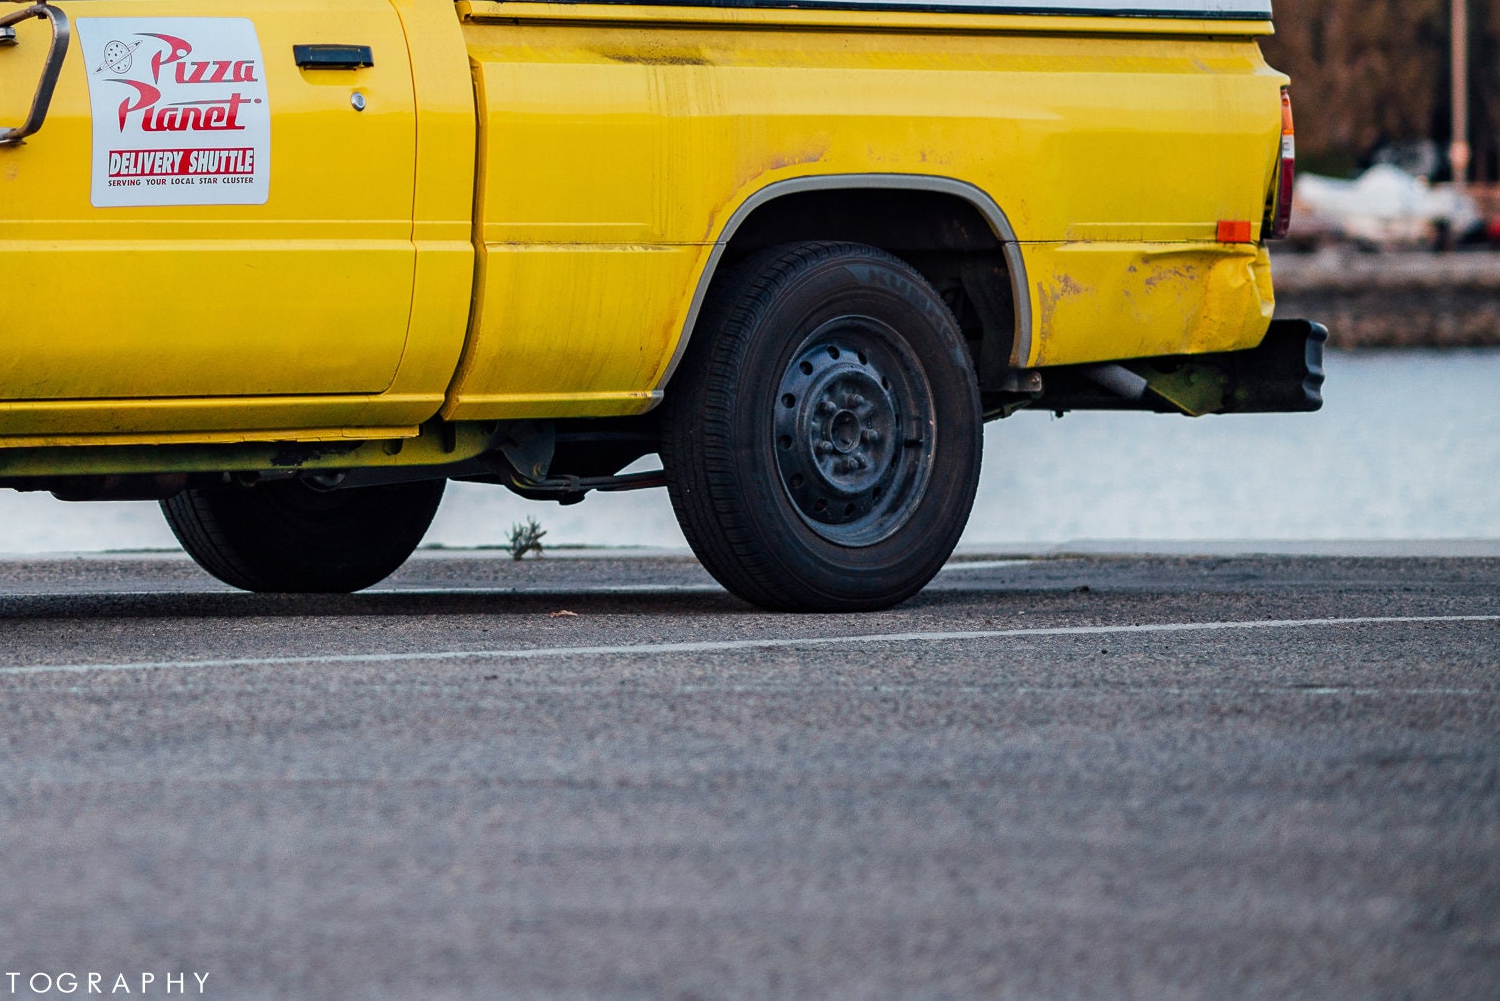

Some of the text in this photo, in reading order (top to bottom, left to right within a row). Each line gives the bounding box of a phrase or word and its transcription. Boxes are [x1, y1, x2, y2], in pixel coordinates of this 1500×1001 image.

[132, 32, 258, 85] Pizza
[102, 78, 251, 133] Planet
[110, 149, 253, 175] DELIVERY SHUTTLE
[171, 177, 194, 185] LOCAL
[199, 177, 218, 185] STAR
[223, 176, 254, 184] CLUSTER
